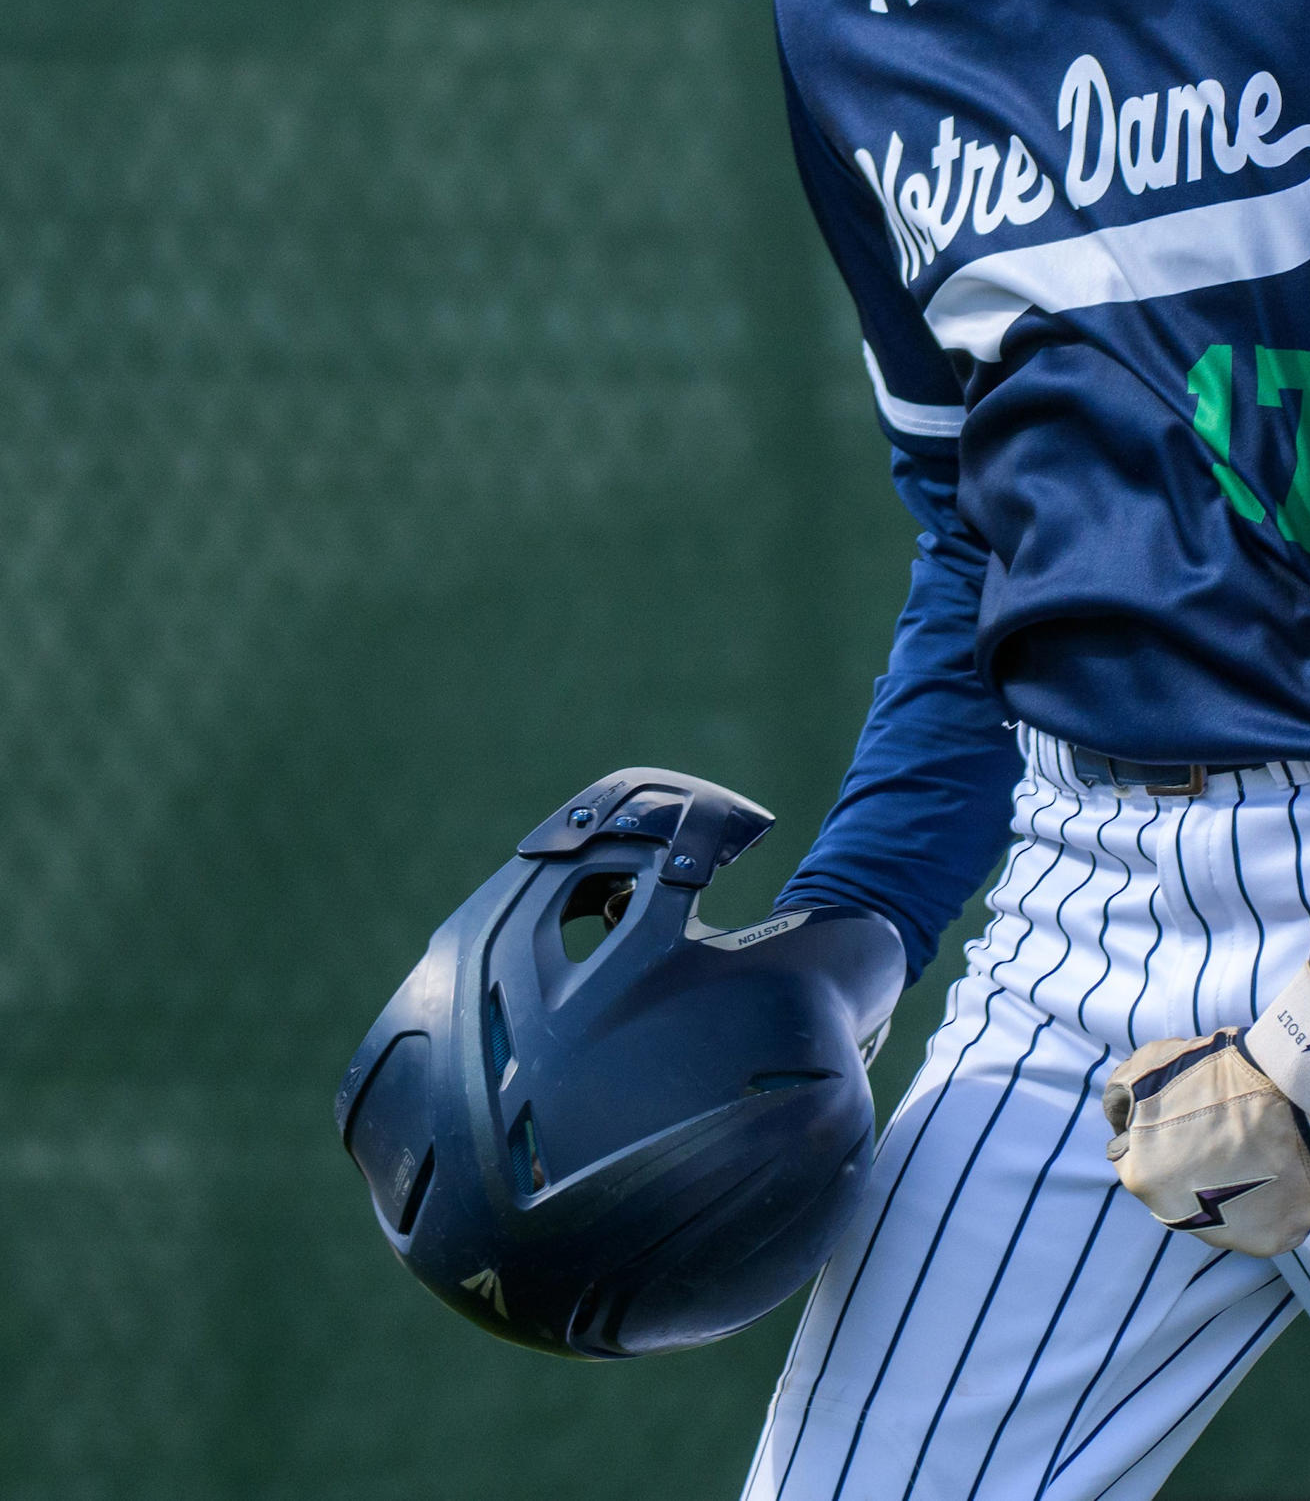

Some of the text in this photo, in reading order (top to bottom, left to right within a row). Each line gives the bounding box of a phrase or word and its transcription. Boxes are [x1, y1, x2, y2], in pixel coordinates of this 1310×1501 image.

[854, 53, 1300, 289] Notre Dame
[738, 919, 789, 946] EASTON
[1277, 1010, 1307, 1046] BOLT
